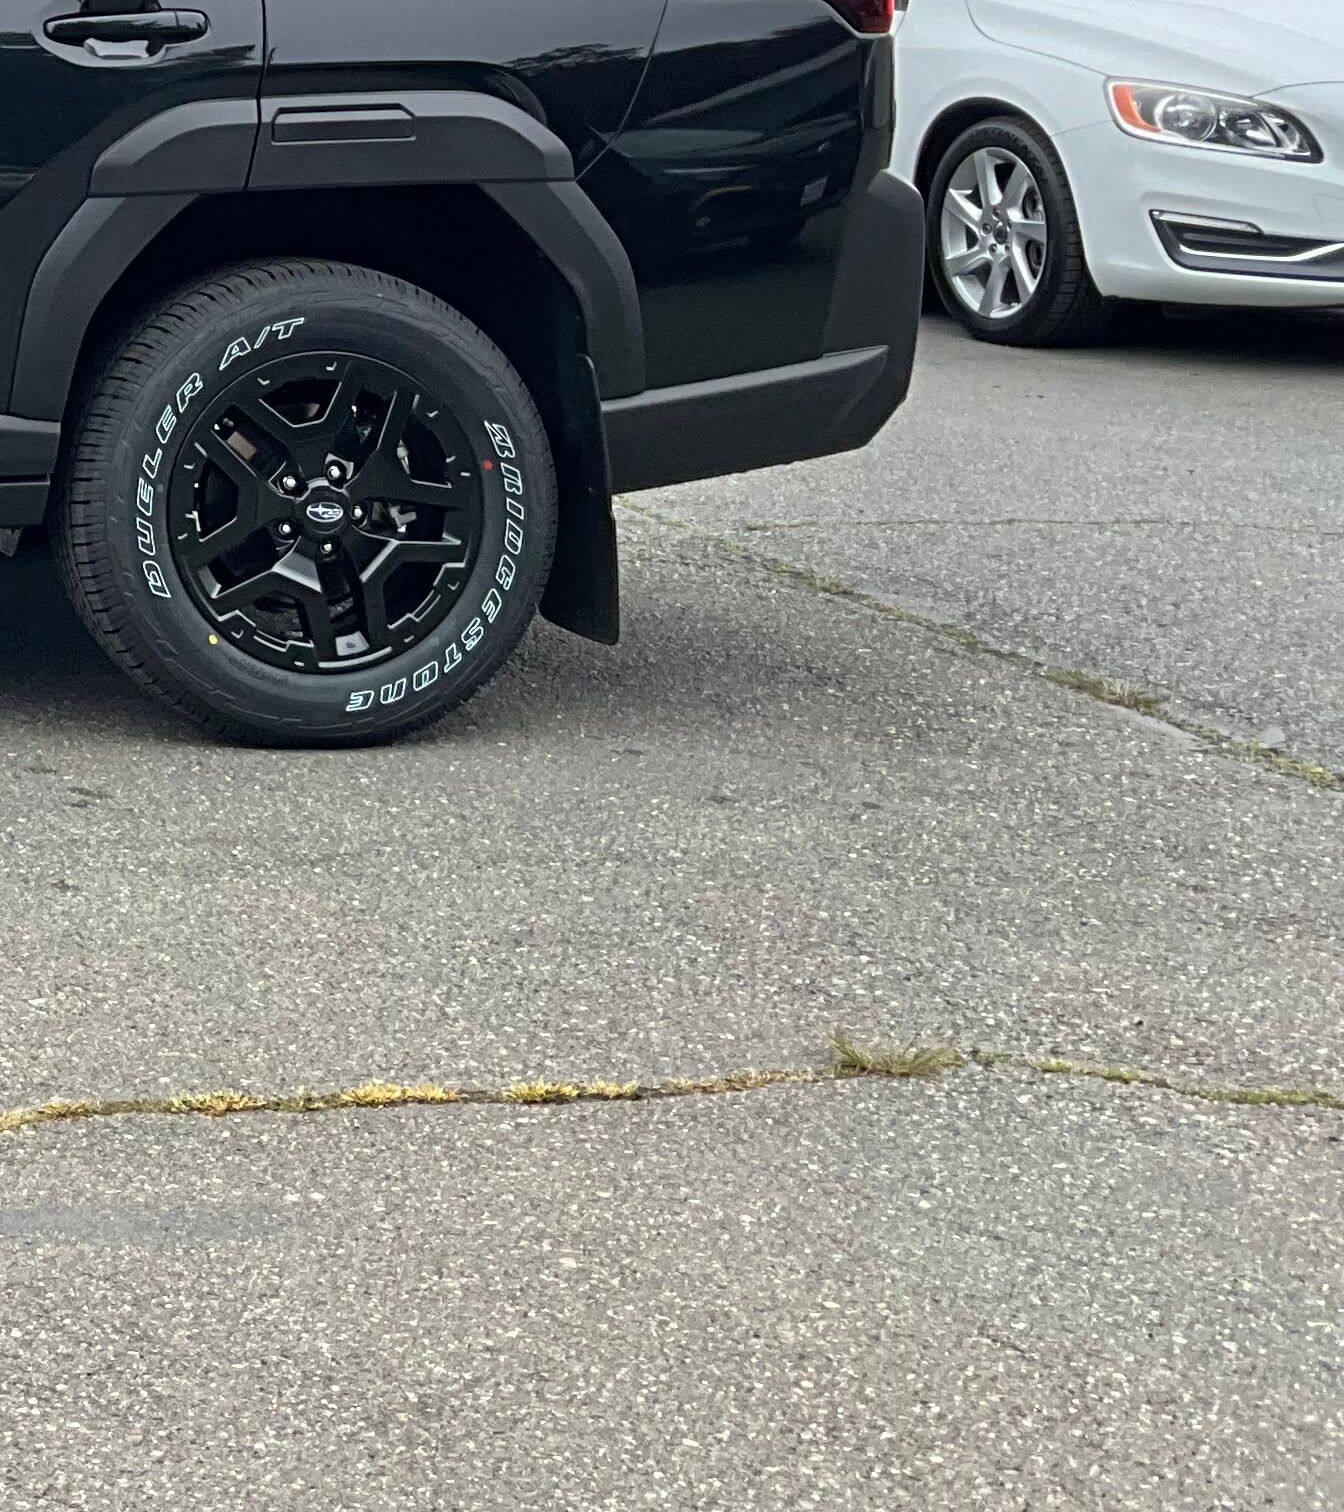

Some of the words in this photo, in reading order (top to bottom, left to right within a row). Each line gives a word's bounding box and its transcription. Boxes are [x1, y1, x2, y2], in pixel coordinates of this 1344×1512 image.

[218, 317, 305, 371] A/T
[134, 372, 205, 599] DUELER
[345, 421, 525, 712] BRIDGESTONE
